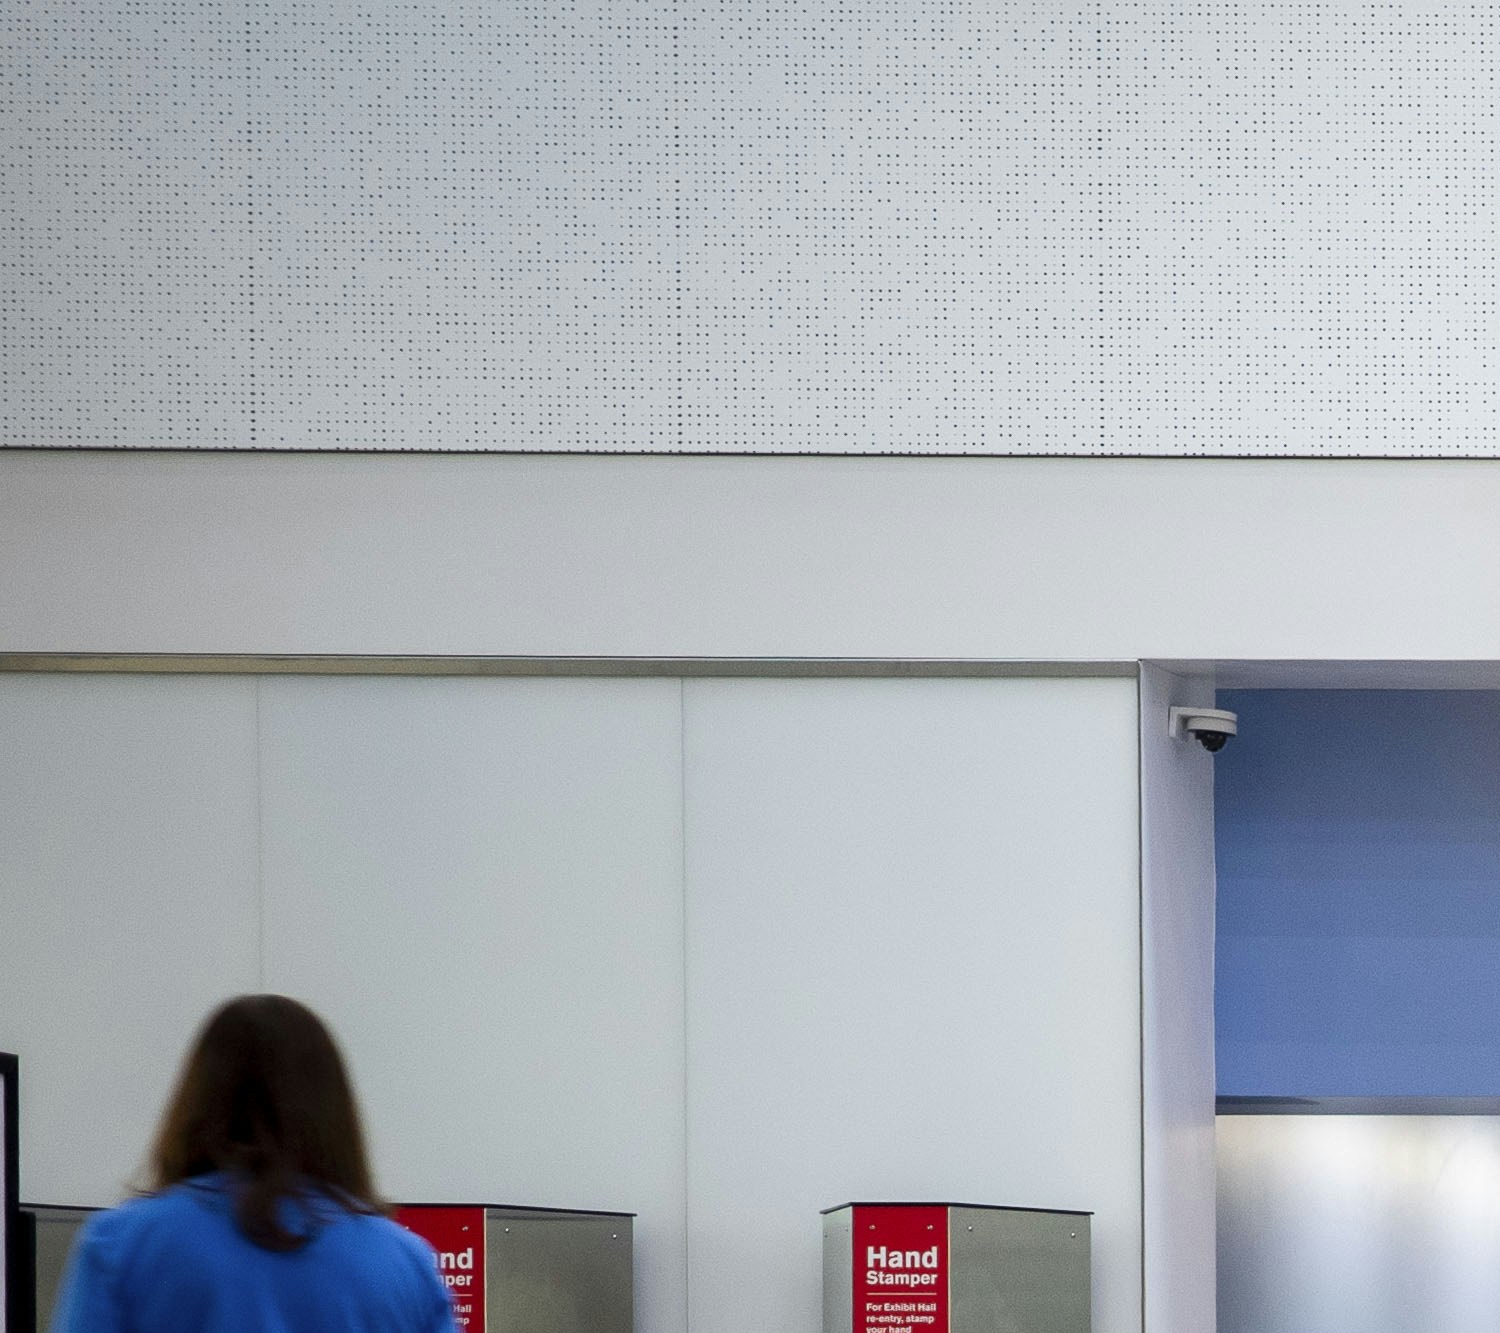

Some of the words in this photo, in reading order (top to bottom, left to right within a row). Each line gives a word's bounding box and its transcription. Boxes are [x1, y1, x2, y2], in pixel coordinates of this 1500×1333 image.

[433, 1247, 473, 1269] nd
[866, 1245, 938, 1269] Hand
[866, 1270, 938, 1288] Stamper
[866, 1303, 882, 1312] For
[883, 1302, 916, 1312] Exhibit
[917, 1302, 937, 1312] Hall
[866, 1315, 904, 1324] re-entry,
[905, 1315, 935, 1324] stamp
[888, 1325, 912, 1333] hand
